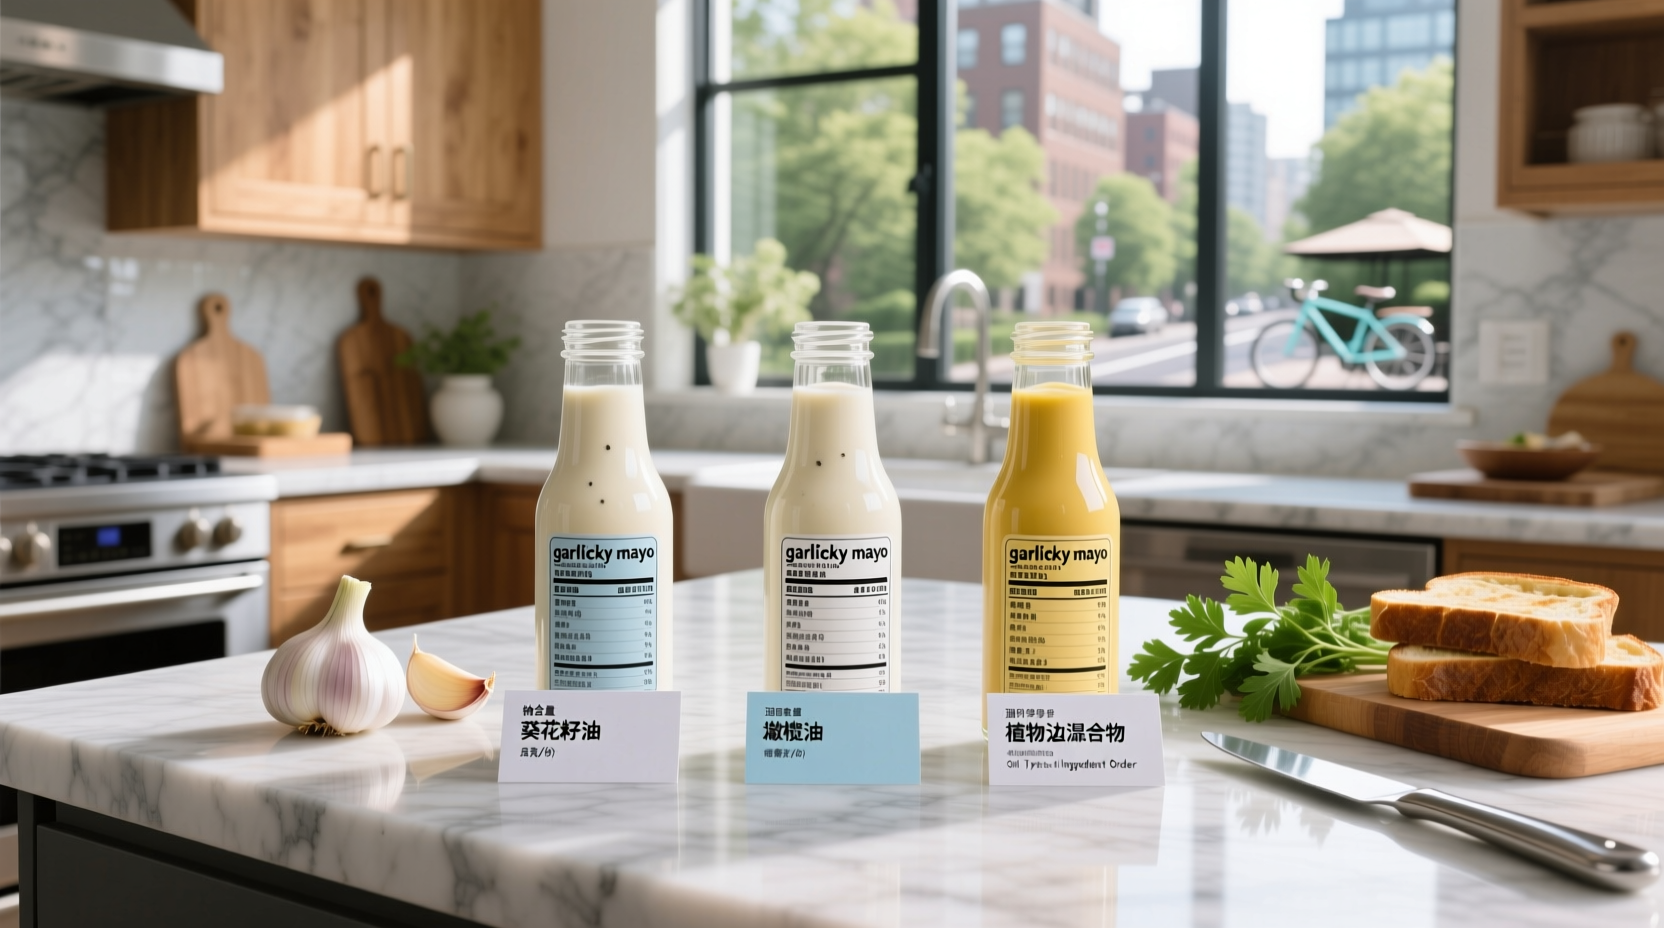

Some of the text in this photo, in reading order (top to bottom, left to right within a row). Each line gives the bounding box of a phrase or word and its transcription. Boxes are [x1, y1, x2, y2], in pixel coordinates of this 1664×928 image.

[553, 544, 655, 564] garlicky mayo
[785, 544, 888, 565] garlicky mayo
[1009, 545, 1108, 566] garlicky mayo
[520, 719, 601, 741] 葵花籽油
[1109, 758, 1137, 769] Order
